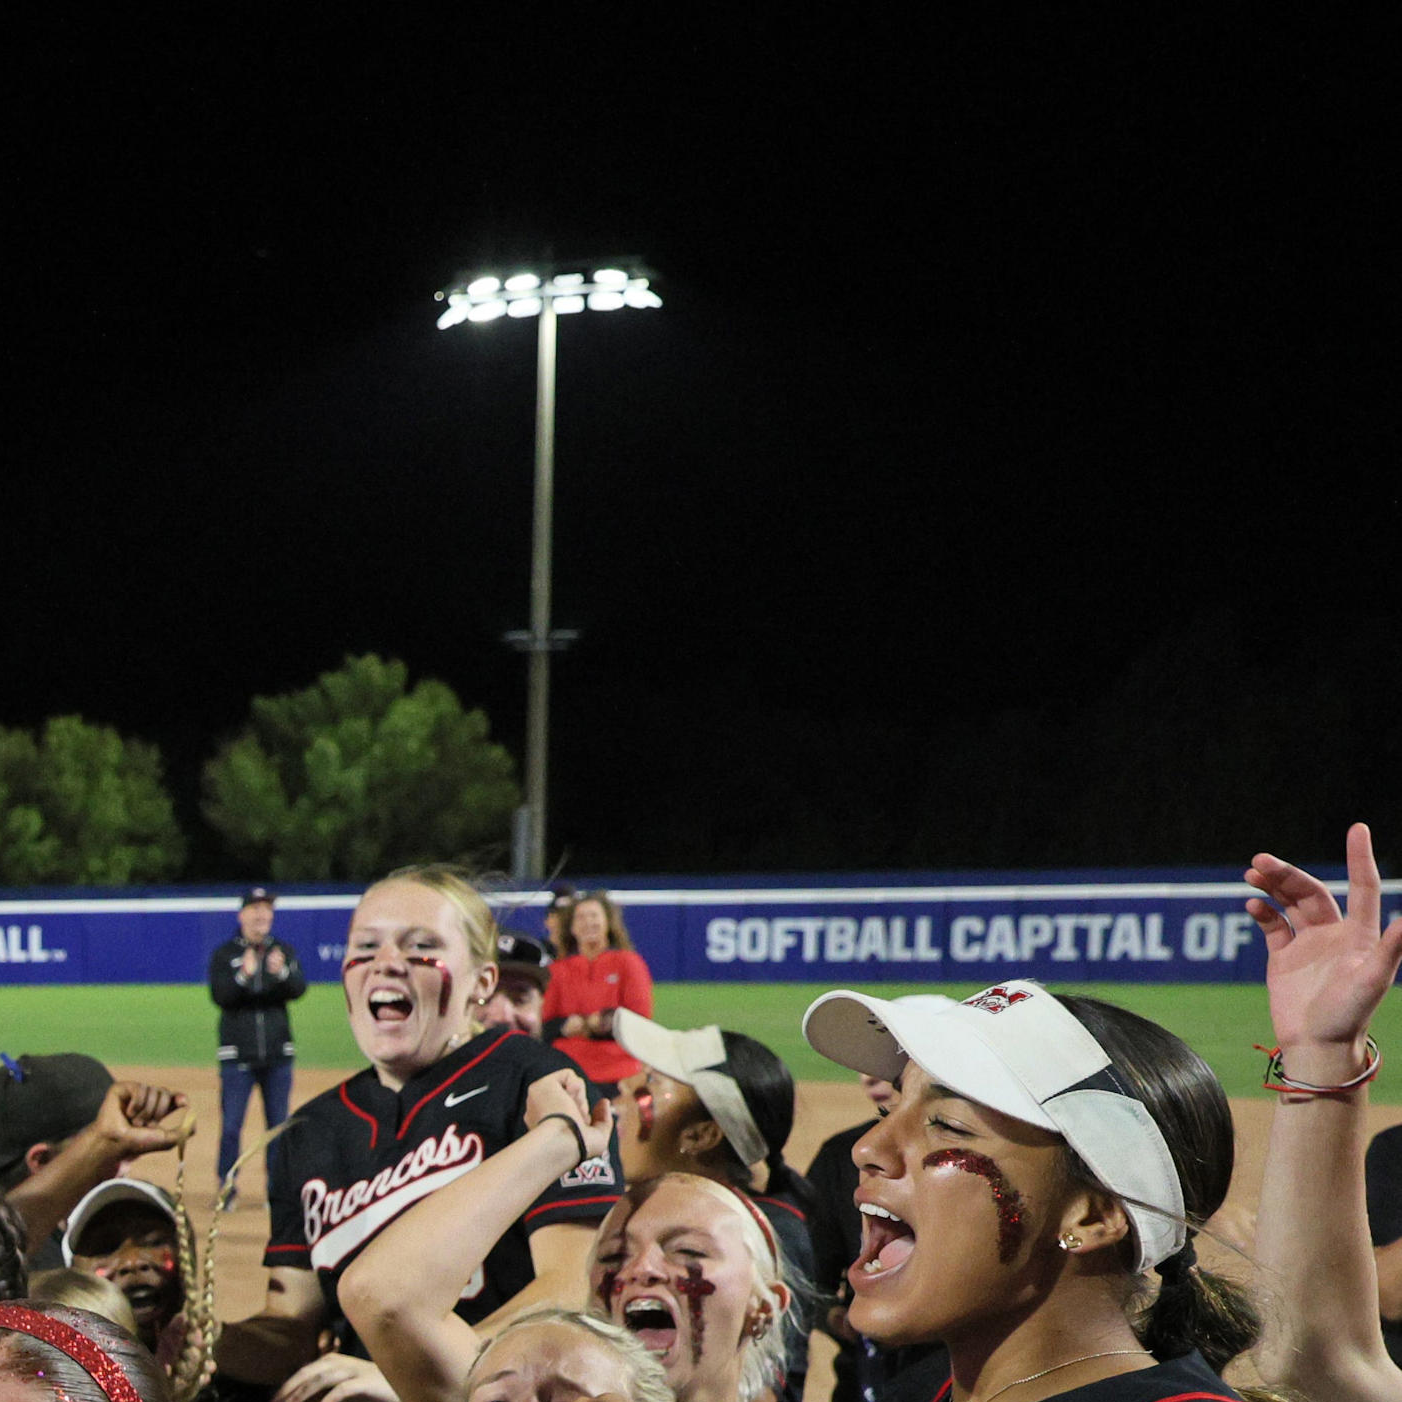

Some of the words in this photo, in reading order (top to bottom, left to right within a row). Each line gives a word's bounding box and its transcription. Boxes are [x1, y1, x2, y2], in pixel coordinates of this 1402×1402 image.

[706, 916, 941, 963] SOFTBALL
[950, 914, 1172, 962] CAPITAL
[1183, 913, 1254, 962] OF
